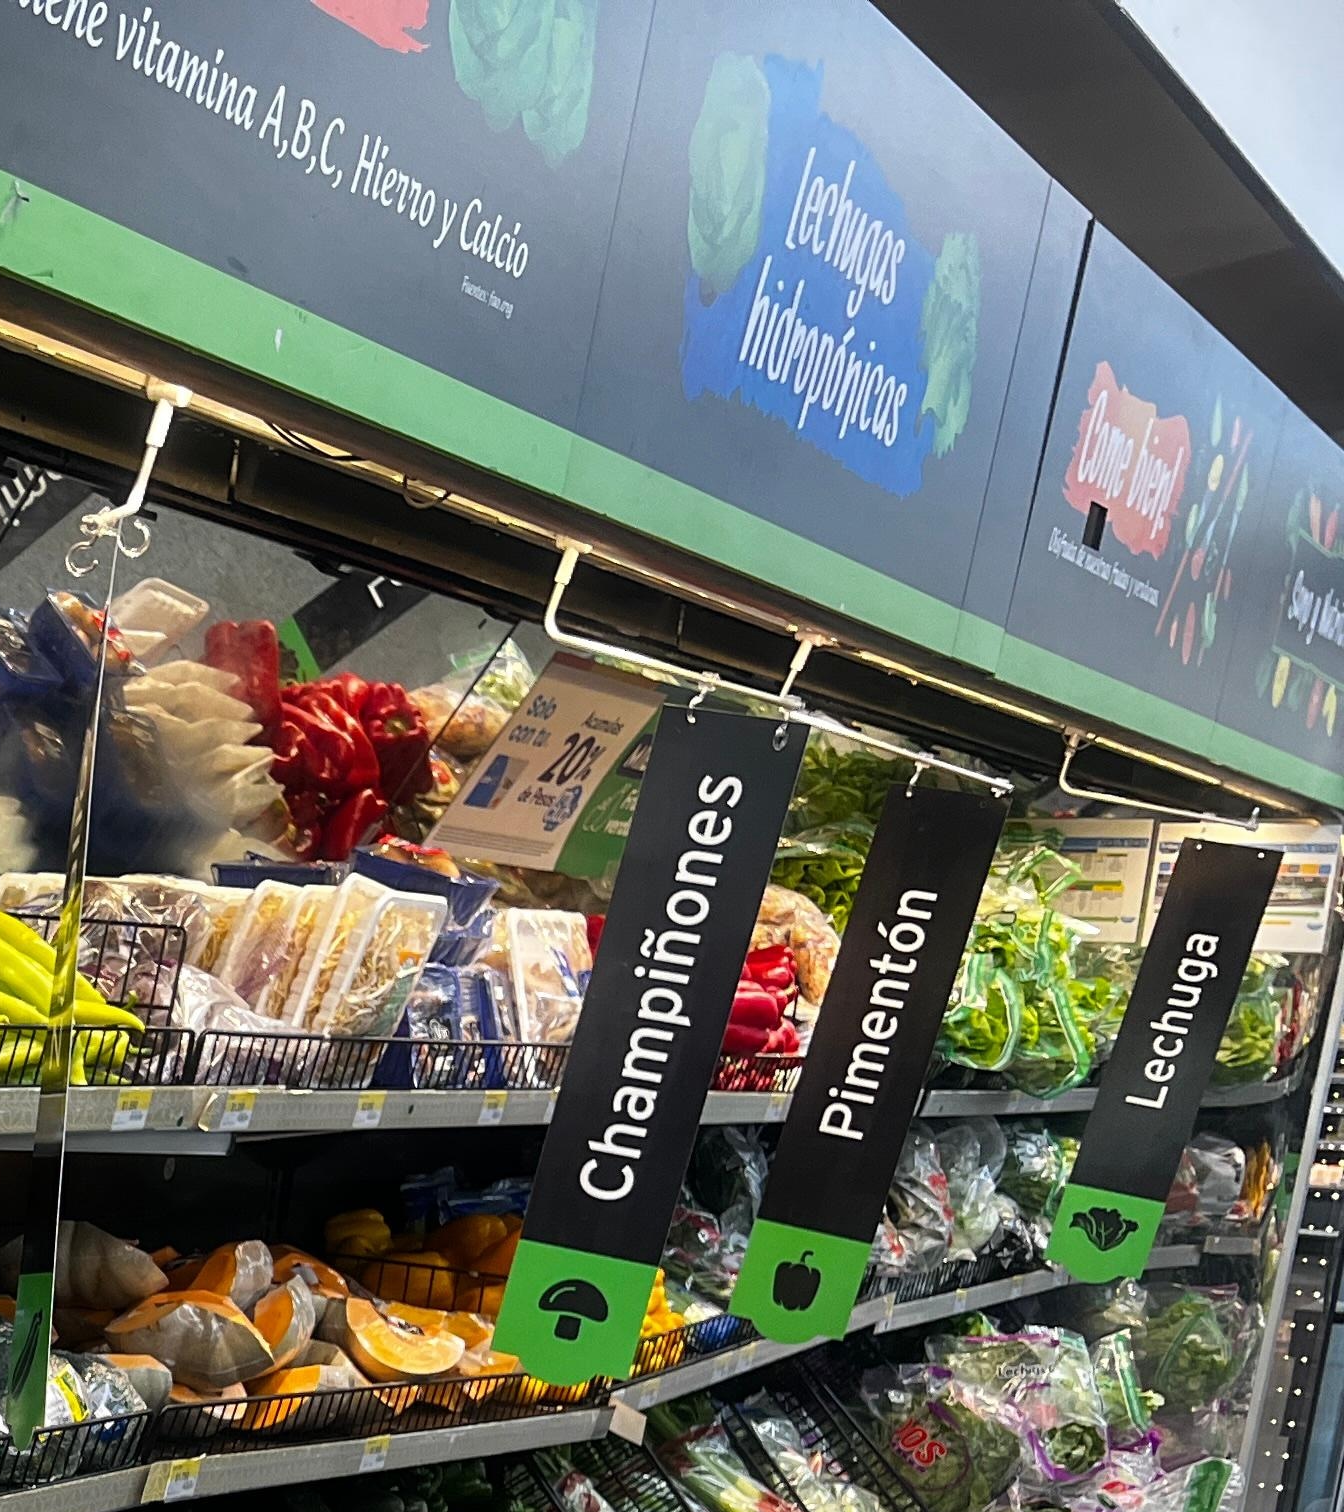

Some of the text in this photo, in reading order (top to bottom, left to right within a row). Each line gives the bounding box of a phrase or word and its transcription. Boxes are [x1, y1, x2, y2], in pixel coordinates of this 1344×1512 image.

[19, 0, 108, 47] ene
[115, 6, 258, 131] vitamina
[352, 134, 435, 228] Hierro
[433, 198, 458, 248] y
[459, 198, 529, 279] Calcio
[786, 147, 906, 318] Lechugas
[739, 255, 908, 447] hidropónicas
[1078, 389, 1134, 500] Come
[537, 732, 607, 786] 20%
[578, 771, 744, 1202] Champiñones
[818, 887, 939, 1142] Pimentón
[1124, 931, 1222, 1112] Lechuga
